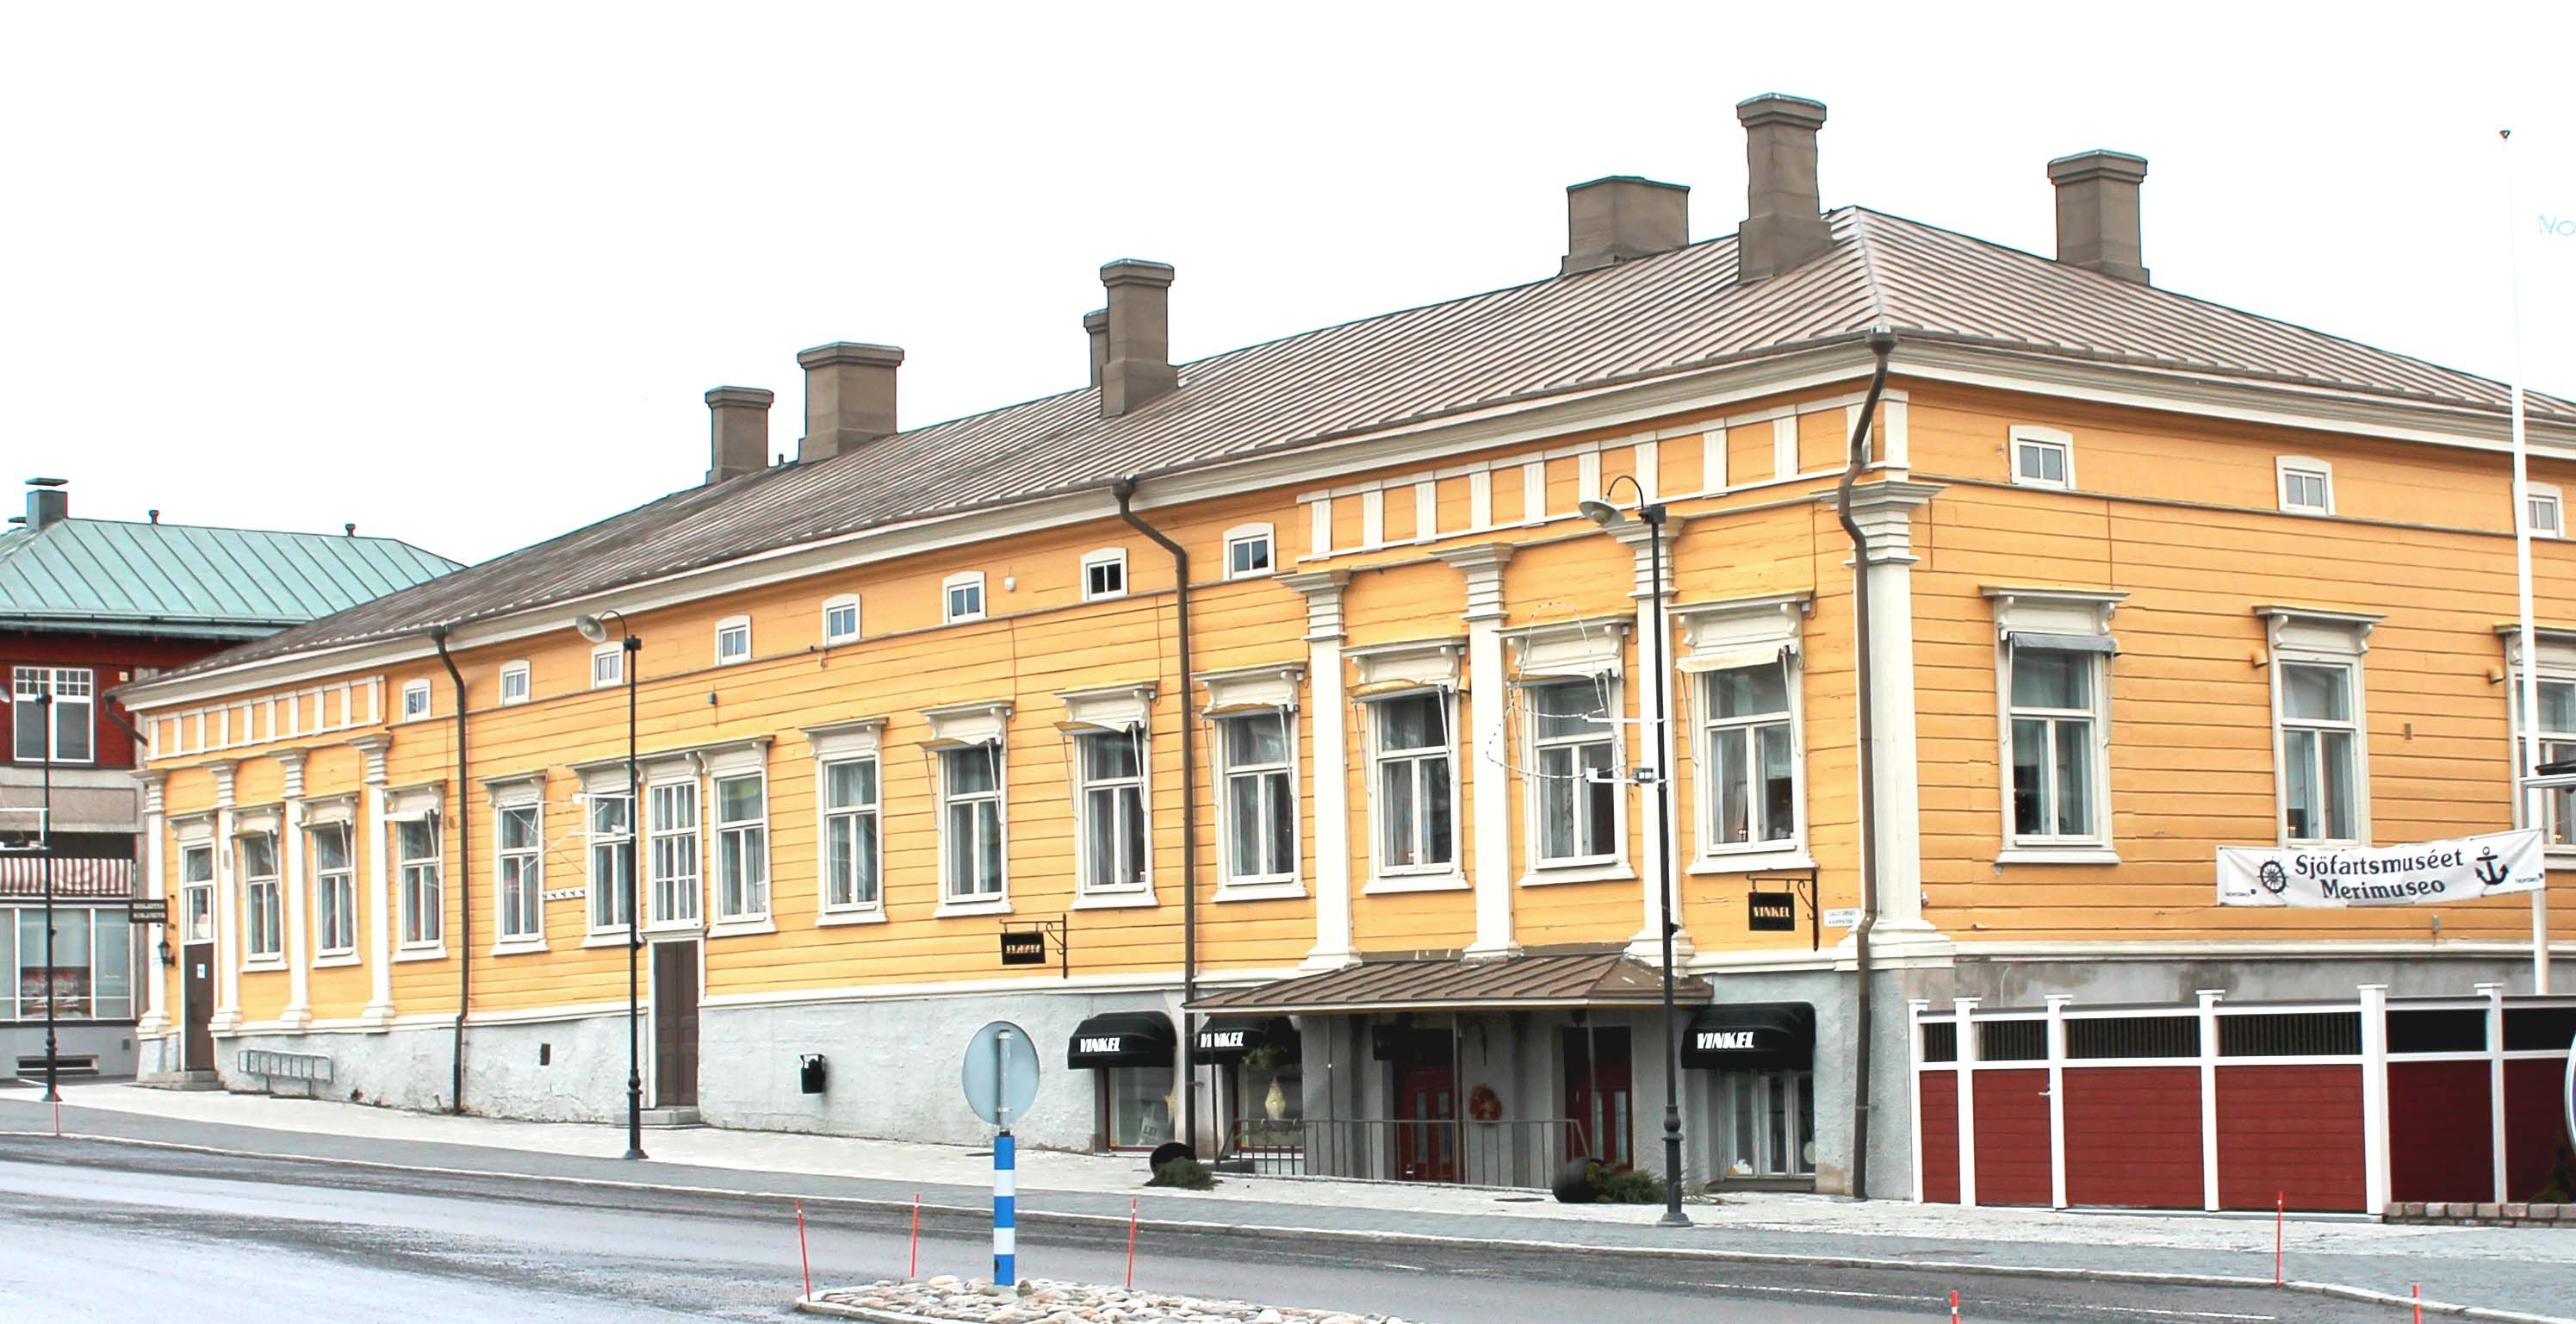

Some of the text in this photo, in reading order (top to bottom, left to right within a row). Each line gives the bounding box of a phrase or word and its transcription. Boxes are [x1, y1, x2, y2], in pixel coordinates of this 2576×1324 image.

[2294, 848, 2463, 879] Sjöfartsmuséet
[2320, 879, 2445, 898] Merimuseo
[1753, 906, 1791, 918] VINKEL
[1079, 1037, 1120, 1053] VINKEL
[1697, 1031, 1754, 1049] VINKEL
